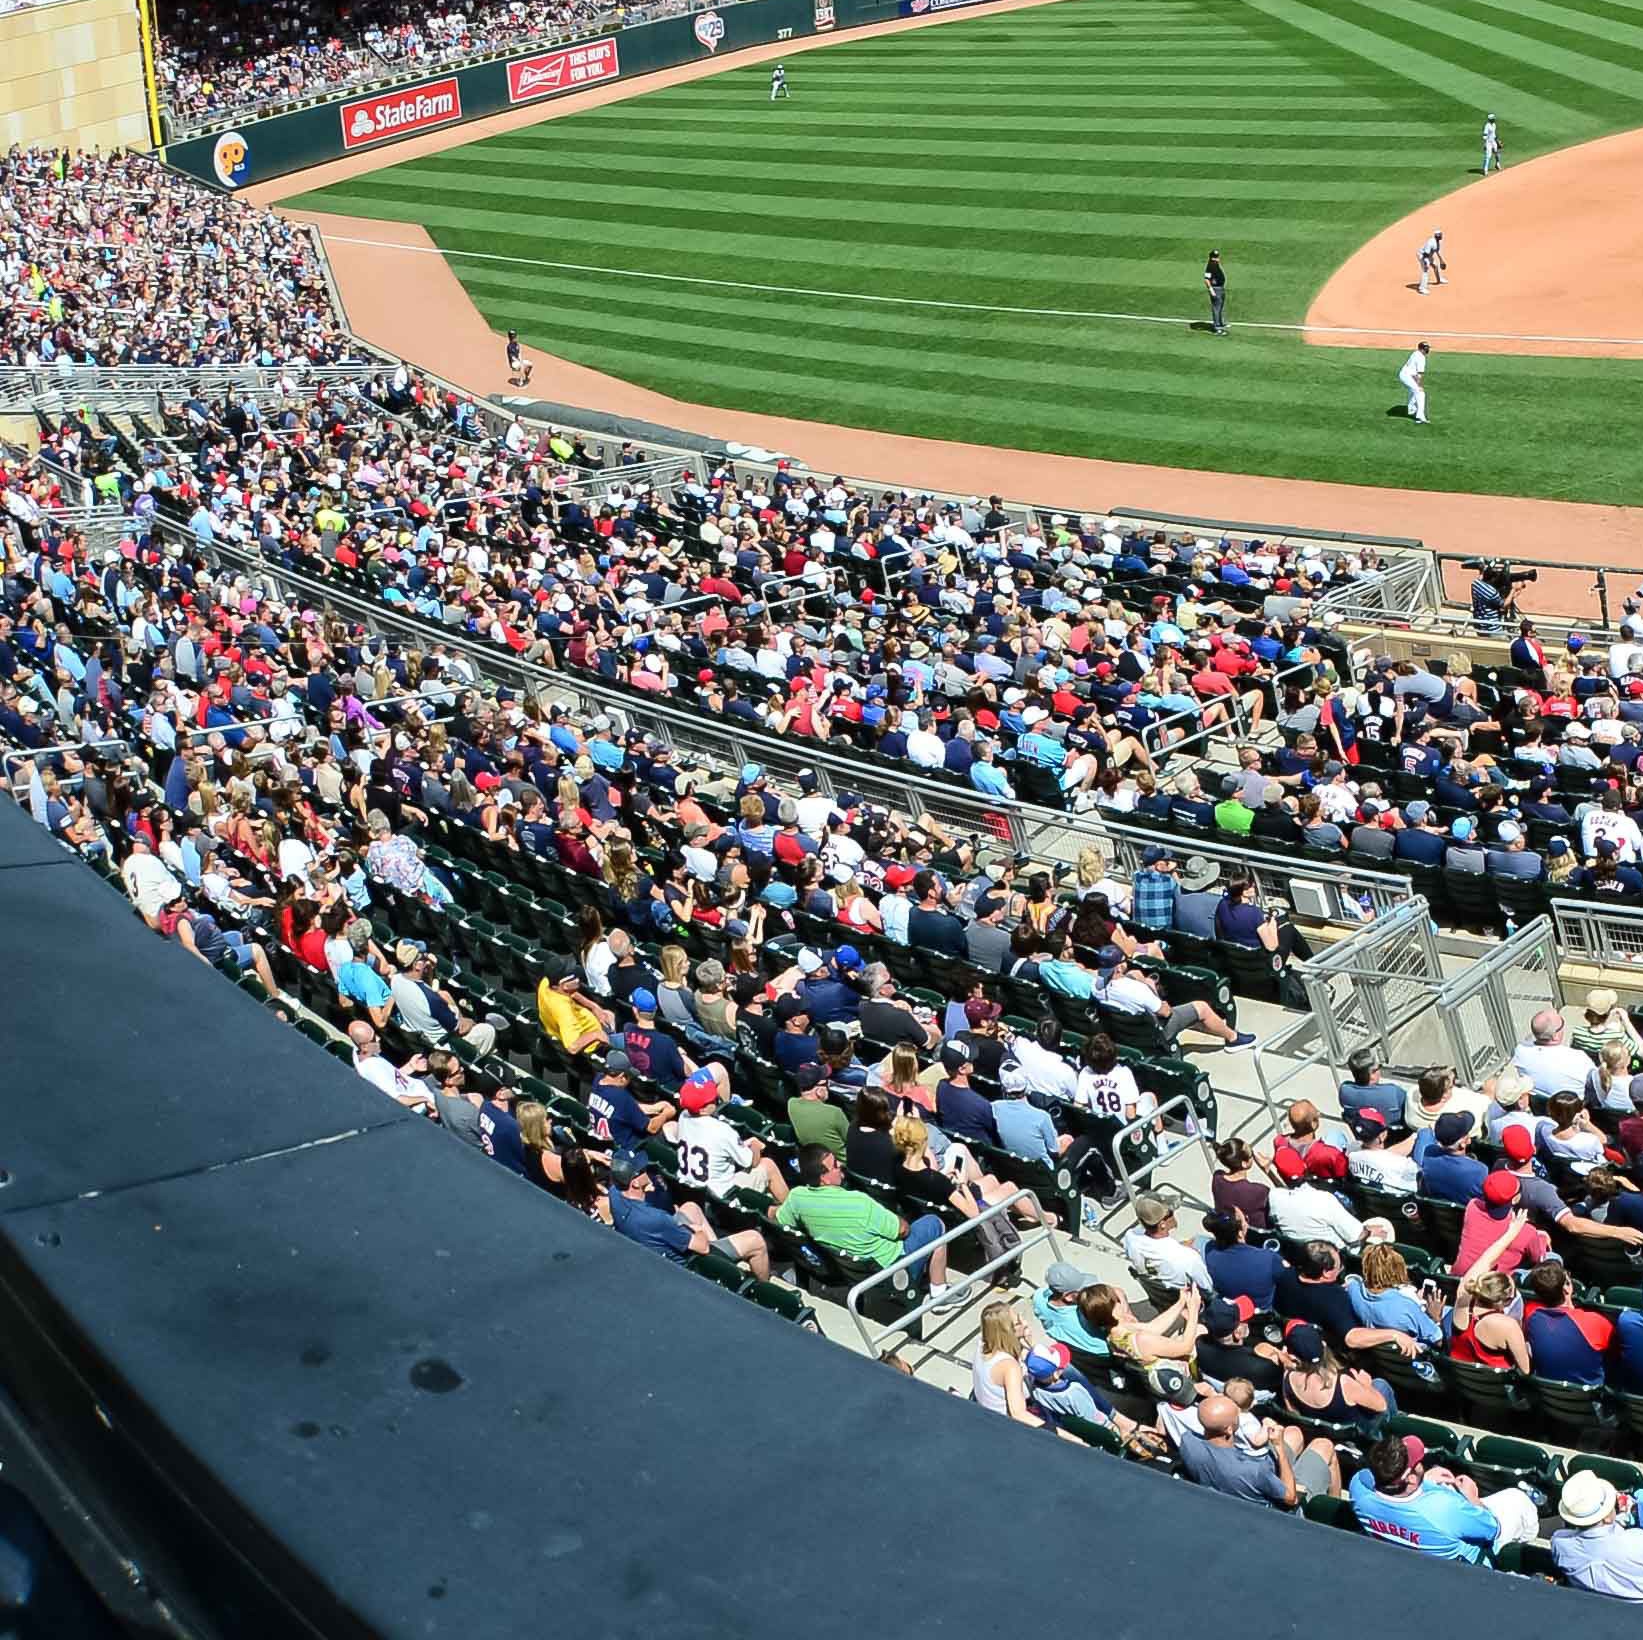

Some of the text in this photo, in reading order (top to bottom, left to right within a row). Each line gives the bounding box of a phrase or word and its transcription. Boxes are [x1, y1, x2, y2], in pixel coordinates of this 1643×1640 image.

[777, 28, 793, 40] 377
[569, 51, 588, 67] THIS
[520, 65, 564, 88] Budweiser
[570, 65, 588, 80] FOR
[1366, 725, 1381, 741] 15
[1096, 1091, 1121, 1113] 48
